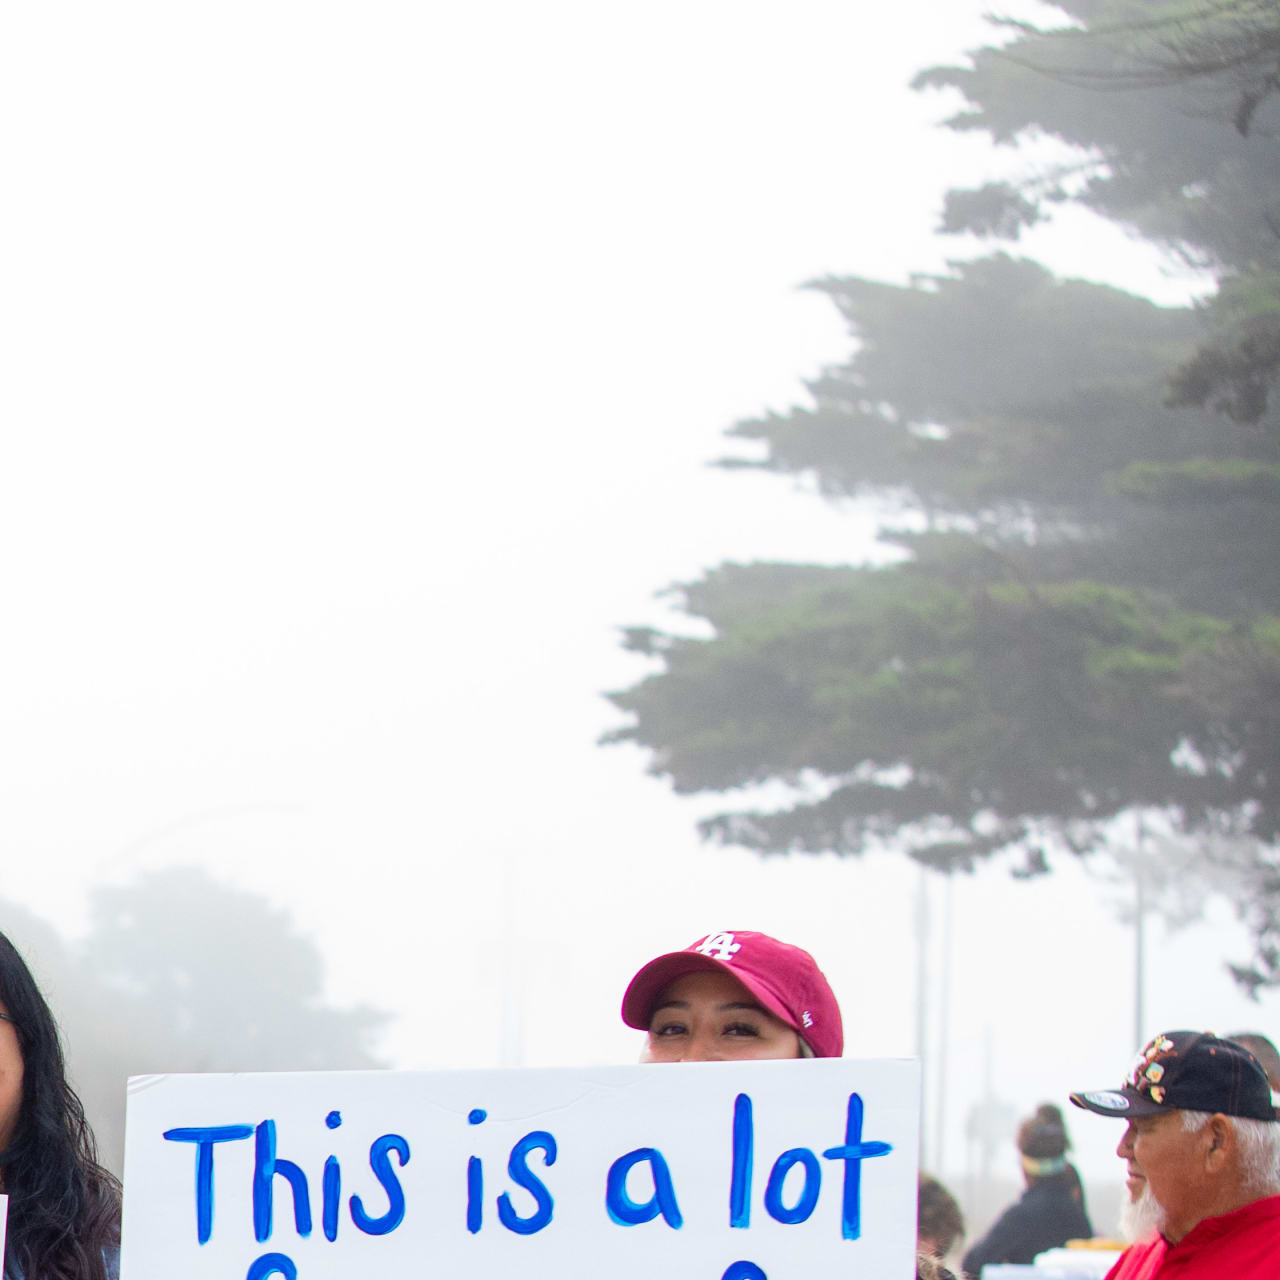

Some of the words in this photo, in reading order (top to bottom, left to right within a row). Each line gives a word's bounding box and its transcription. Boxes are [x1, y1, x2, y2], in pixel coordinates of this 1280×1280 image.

[163, 1110, 411, 1246] This
[466, 1108, 558, 1236] is
[605, 1147, 684, 1231] a
[730, 1092, 895, 1241] lot
